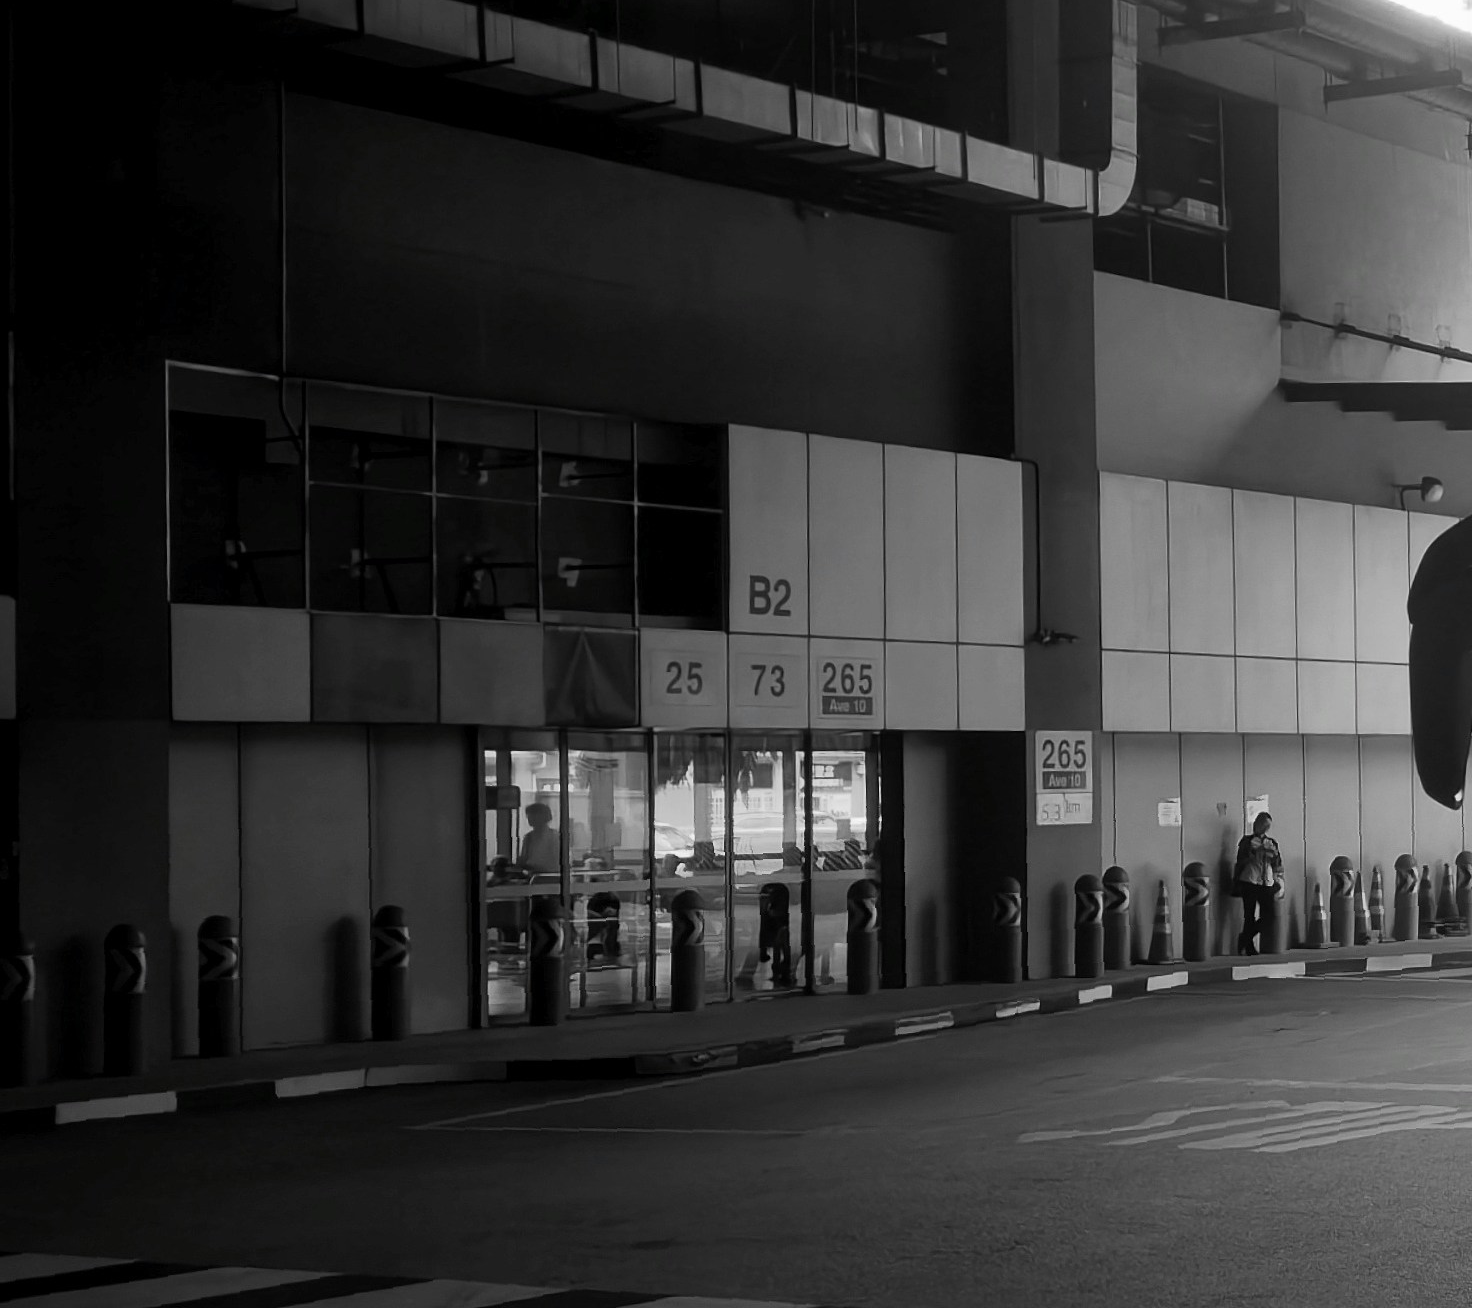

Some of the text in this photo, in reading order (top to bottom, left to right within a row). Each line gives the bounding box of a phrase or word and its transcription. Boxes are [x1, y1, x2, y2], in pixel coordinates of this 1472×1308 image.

[749, 574, 791, 617] B2
[666, 661, 873, 697] 25 73 265
[853, 698, 867, 713] 10
[1042, 739, 1087, 769] 265
[1070, 773, 1081, 787] 10
